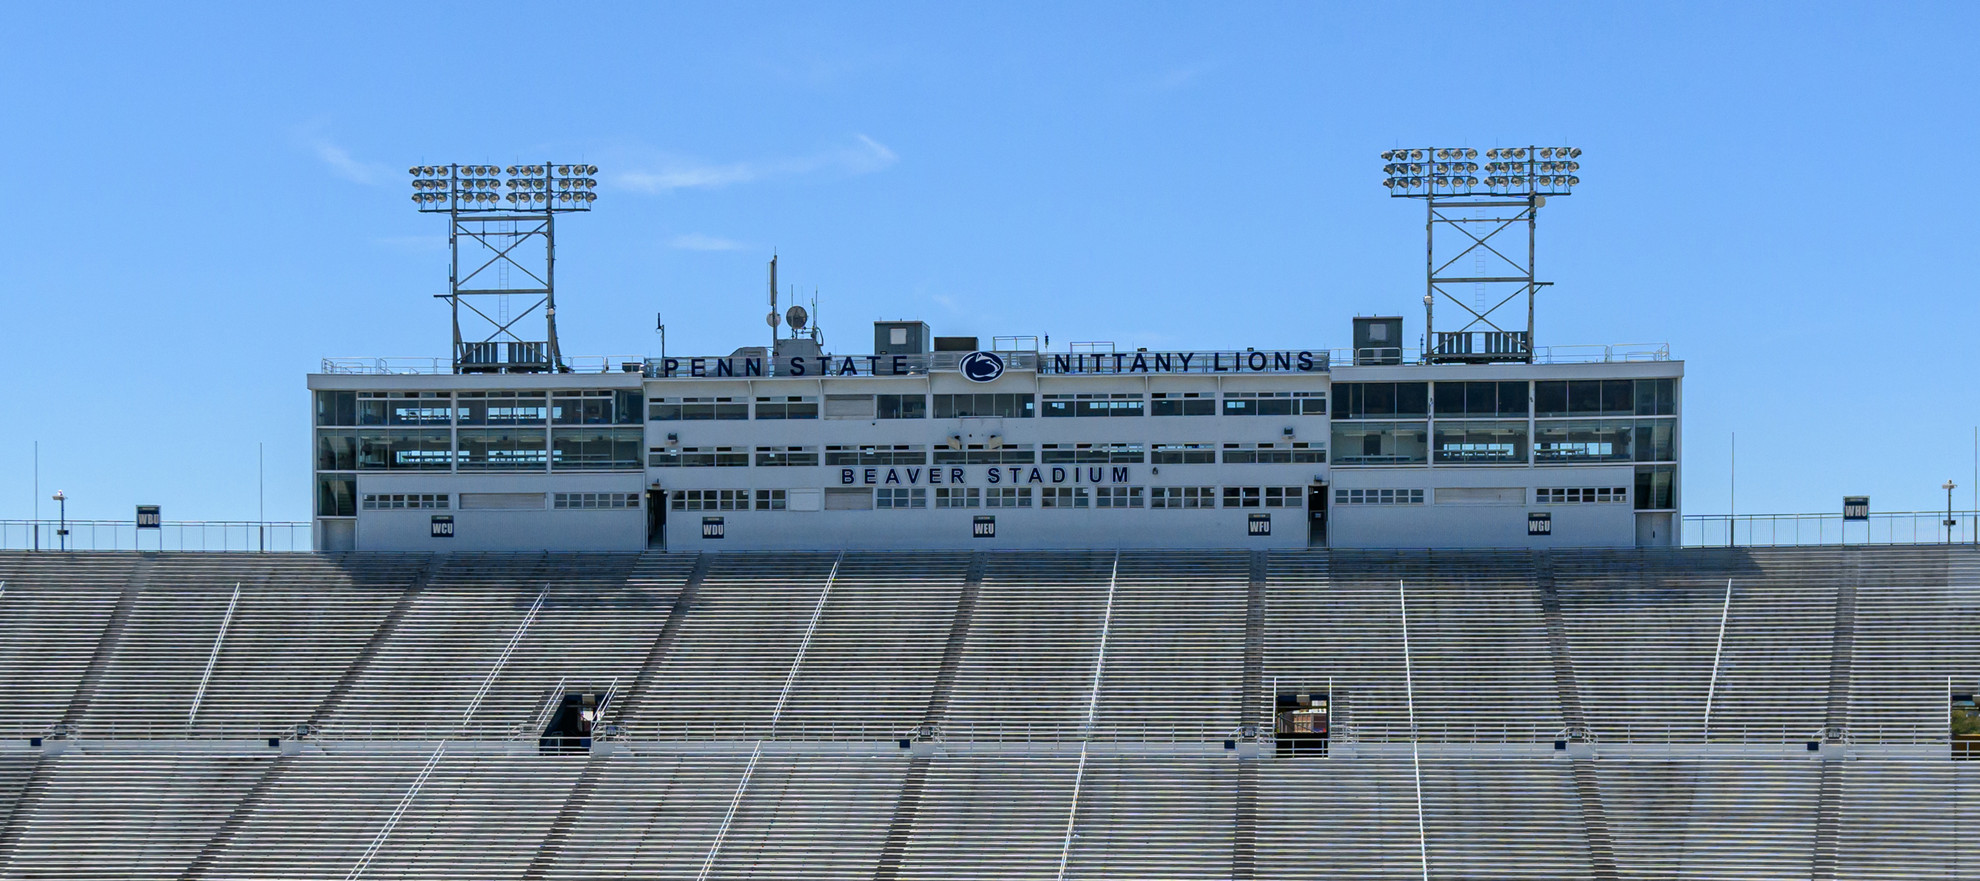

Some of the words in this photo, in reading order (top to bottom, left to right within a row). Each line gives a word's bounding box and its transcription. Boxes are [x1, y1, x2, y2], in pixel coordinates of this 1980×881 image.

[664, 358, 761, 378] PENN
[790, 355, 908, 377] STATE
[1054, 352, 1195, 373] NITTANY
[1214, 351, 1314, 371] LIONS
[841, 468, 966, 484] BEAVER
[987, 466, 1129, 484] STADIUM
[1845, 505, 1867, 517] WHU
[138, 513, 159, 525] WBU
[432, 523, 453, 534] WCU
[703, 524, 724, 535] WDU
[974, 523, 994, 534] WEU
[1249, 521, 1270, 533] WFU
[1528, 520, 1550, 532] WGU
